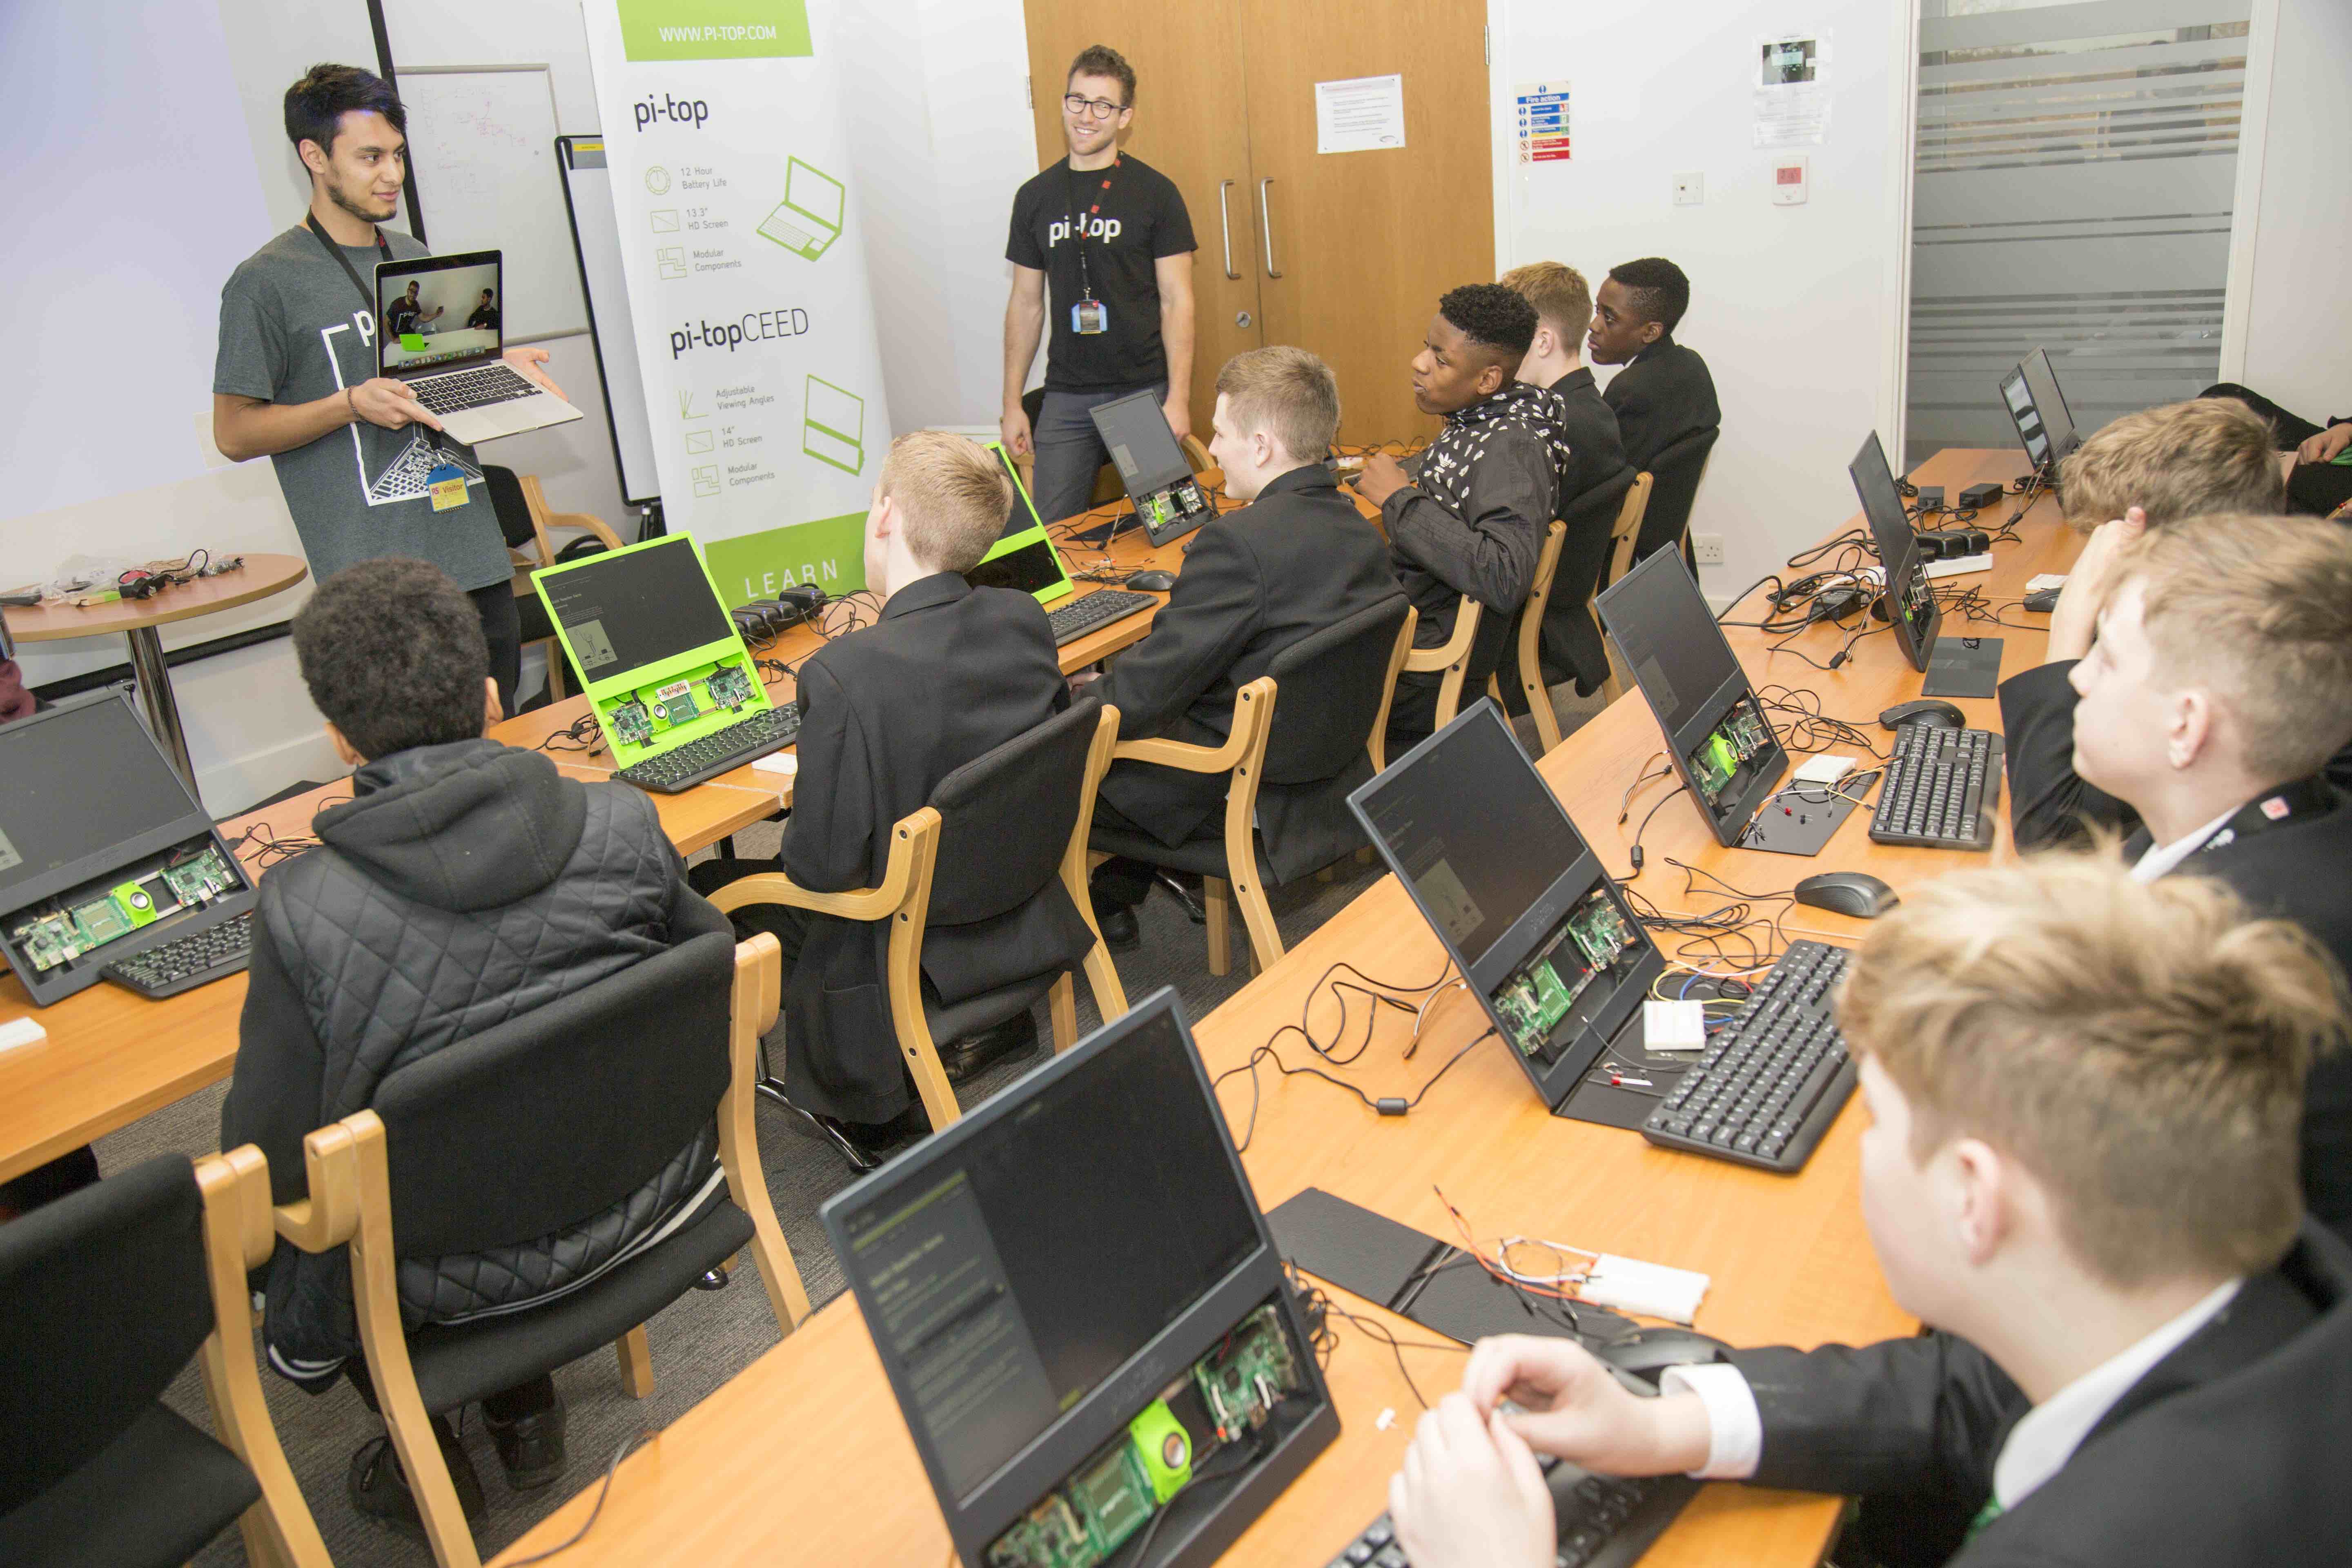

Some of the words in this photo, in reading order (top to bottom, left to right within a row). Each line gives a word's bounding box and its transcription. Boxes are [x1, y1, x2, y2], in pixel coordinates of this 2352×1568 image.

[659, 26, 777, 42] WWW.PI-TOP.COM
[634, 93, 708, 132] pi-top
[681, 168, 690, 176] 12
[695, 167, 713, 176] Hour
[682, 179, 710, 189] Battery
[713, 178, 727, 187] Life
[688, 221, 699, 230] HD
[703, 220, 728, 229] Screen
[693, 248, 724, 259] Modular
[695, 260, 742, 273] Components
[670, 308, 808, 360] pi-topCEED
[715, 385, 755, 399] Adjustable
[717, 399, 746, 410] Viewing
[749, 394, 775, 406] Angles
[723, 439, 734, 448] HD
[738, 435, 763, 446] Screen
[728, 463, 757, 474] Modular
[729, 472, 775, 486] Components
[432, 486, 439, 495] RS
[443, 483, 463, 494] Visitor
[744, 559, 837, 598] LEARN
